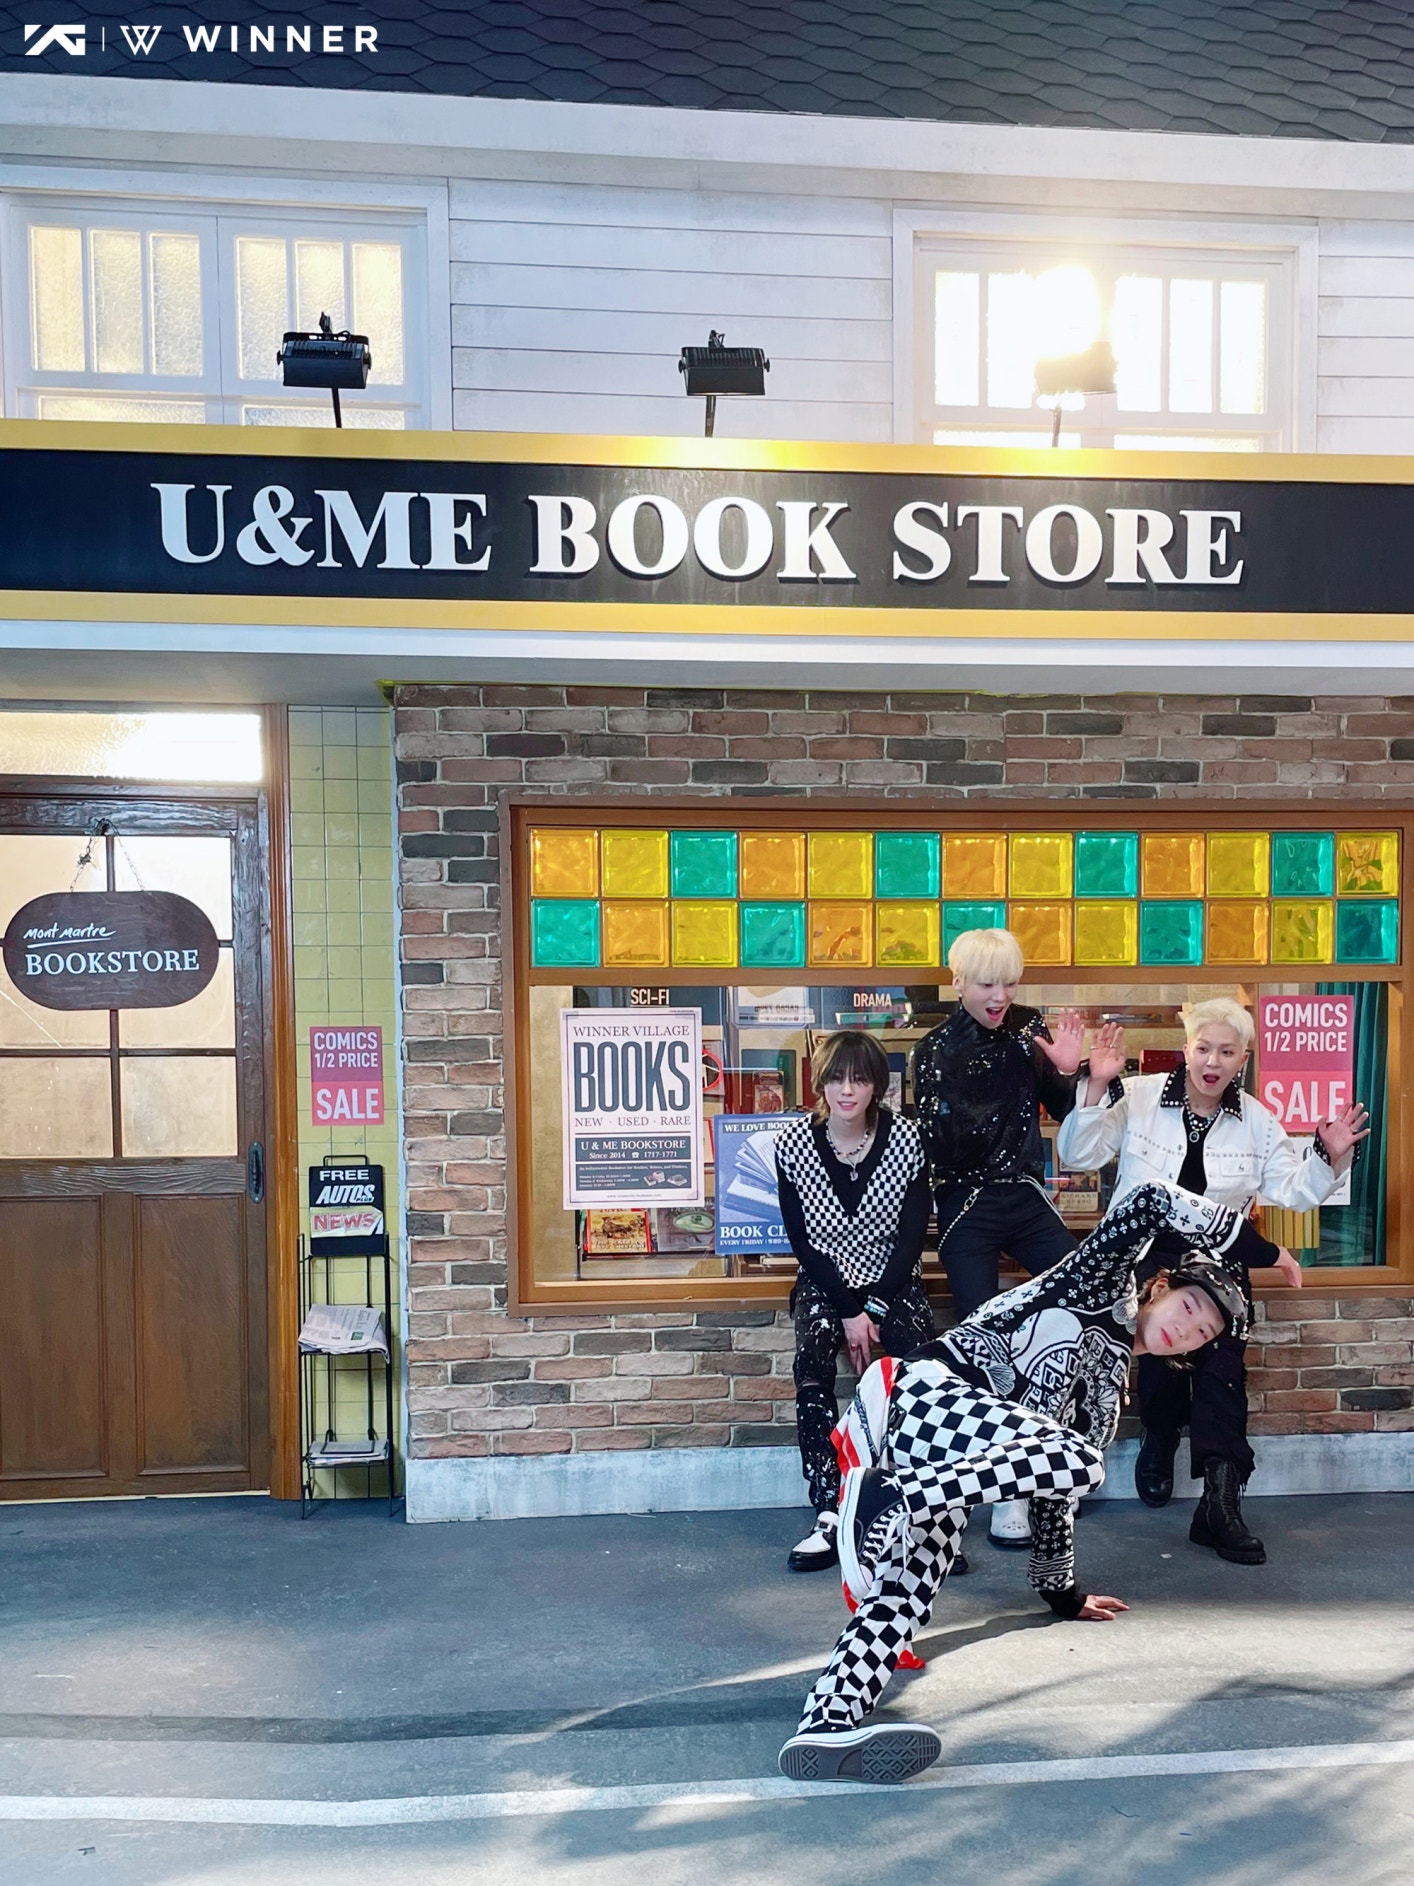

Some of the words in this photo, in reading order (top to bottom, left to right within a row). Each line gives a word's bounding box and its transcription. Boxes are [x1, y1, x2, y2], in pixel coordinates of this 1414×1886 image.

[150, 482, 492, 572] U&ME
[527, 493, 858, 580] BOOK
[892, 500, 1245, 586] STORE
[25, 949, 200, 976] BOOKSTORE
[630, 988, 670, 1005] SCI-FI
[853, 993, 892, 1007] DRAMA
[1264, 1002, 1348, 1028] COMICS
[573, 1026, 630, 1038] WINNER
[633, 1025, 690, 1037] VILLAGE
[313, 1031, 378, 1051] COMICS
[1264, 1031, 1291, 1052] 1/2
[1295, 1031, 1348, 1052] PRICE
[314, 1053, 336, 1068] 1/2
[338, 1052, 379, 1068] PRICE
[573, 1040, 691, 1113] BOOKS
[316, 1088, 380, 1120] SALE
[1264, 1080, 1346, 1123] SALE
[574, 1117, 604, 1128] NEW
[617, 1116, 650, 1127] USED
[660, 1115, 692, 1126] RARE
[724, 1123, 740, 1132] WE
[741, 1122, 766, 1132] LOVE
[767, 1121, 790, 1131] BOO
[581, 1141, 589, 1151] U
[591, 1141, 600, 1151] &
[602, 1140, 618, 1150] ME
[621, 1139, 687, 1150] BOOKSTORE
[320, 1169, 370, 1181] FREE
[315, 1184, 376, 1205] AUTOS
[314, 1213, 376, 1230] NEWS
[719, 1225, 764, 1239] BOOK
[767, 1224, 789, 1237] CL
